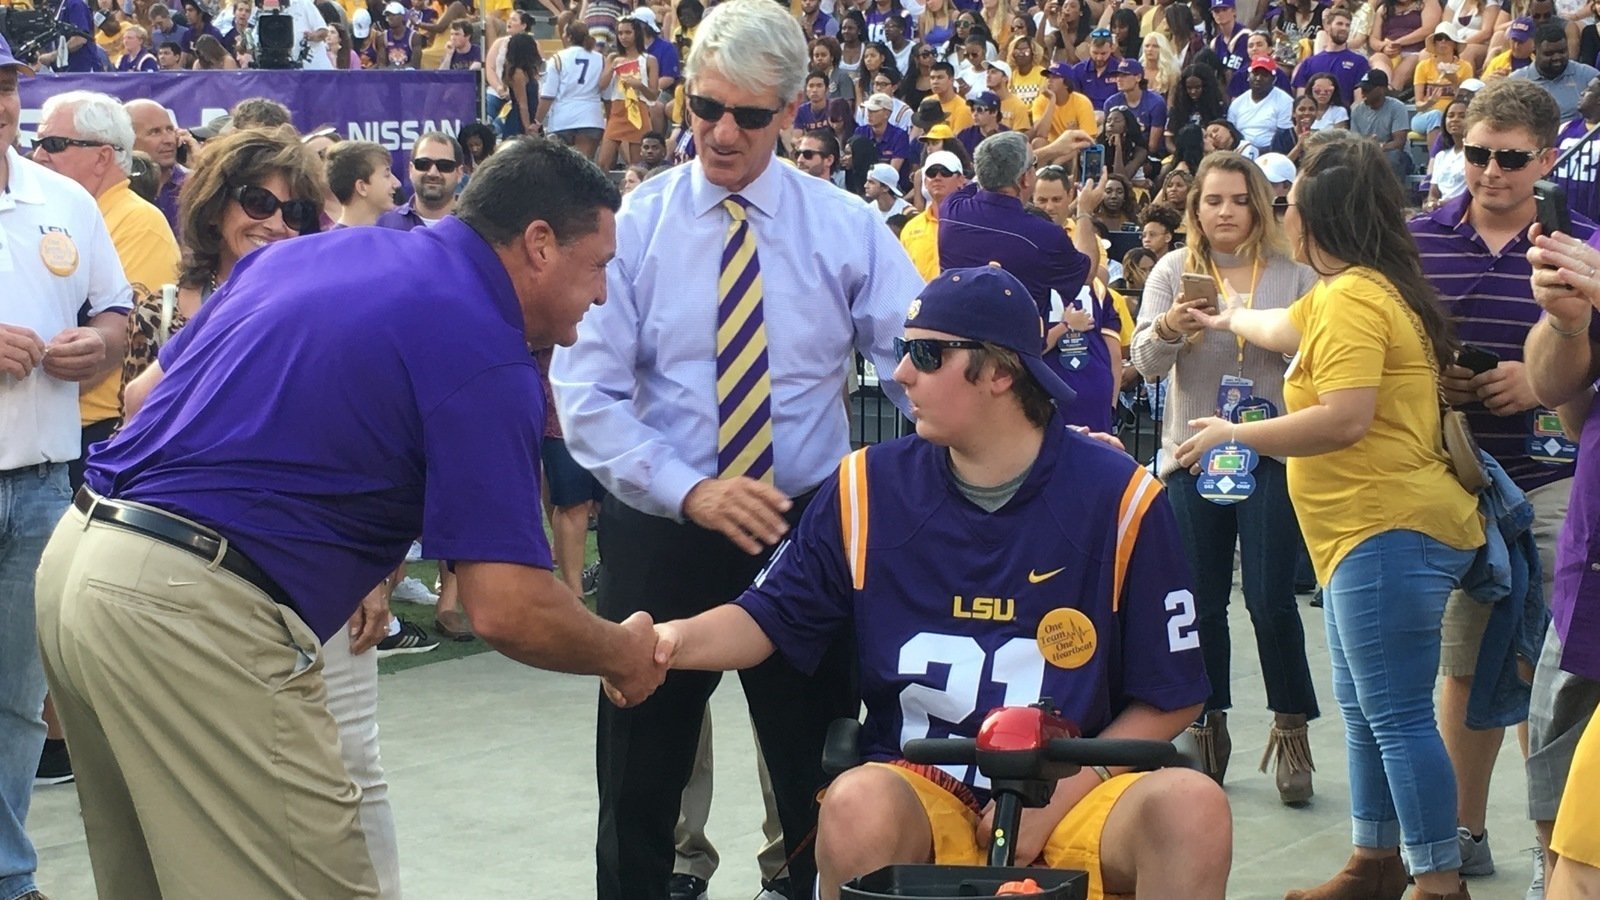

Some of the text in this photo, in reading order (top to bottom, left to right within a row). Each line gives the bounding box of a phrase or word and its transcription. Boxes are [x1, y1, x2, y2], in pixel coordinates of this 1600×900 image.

[575, 58, 590, 84] 7
[348, 119, 460, 150] NISSAN
[953, 595, 1015, 621] LSU
[1164, 588, 1200, 653] 2
[1040, 631, 1067, 646] Team
[1044, 620, 1063, 634] One
[1051, 641, 1093, 662] Heartbeat
[1055, 638, 1074, 651] One
[898, 631, 1046, 790] 21
